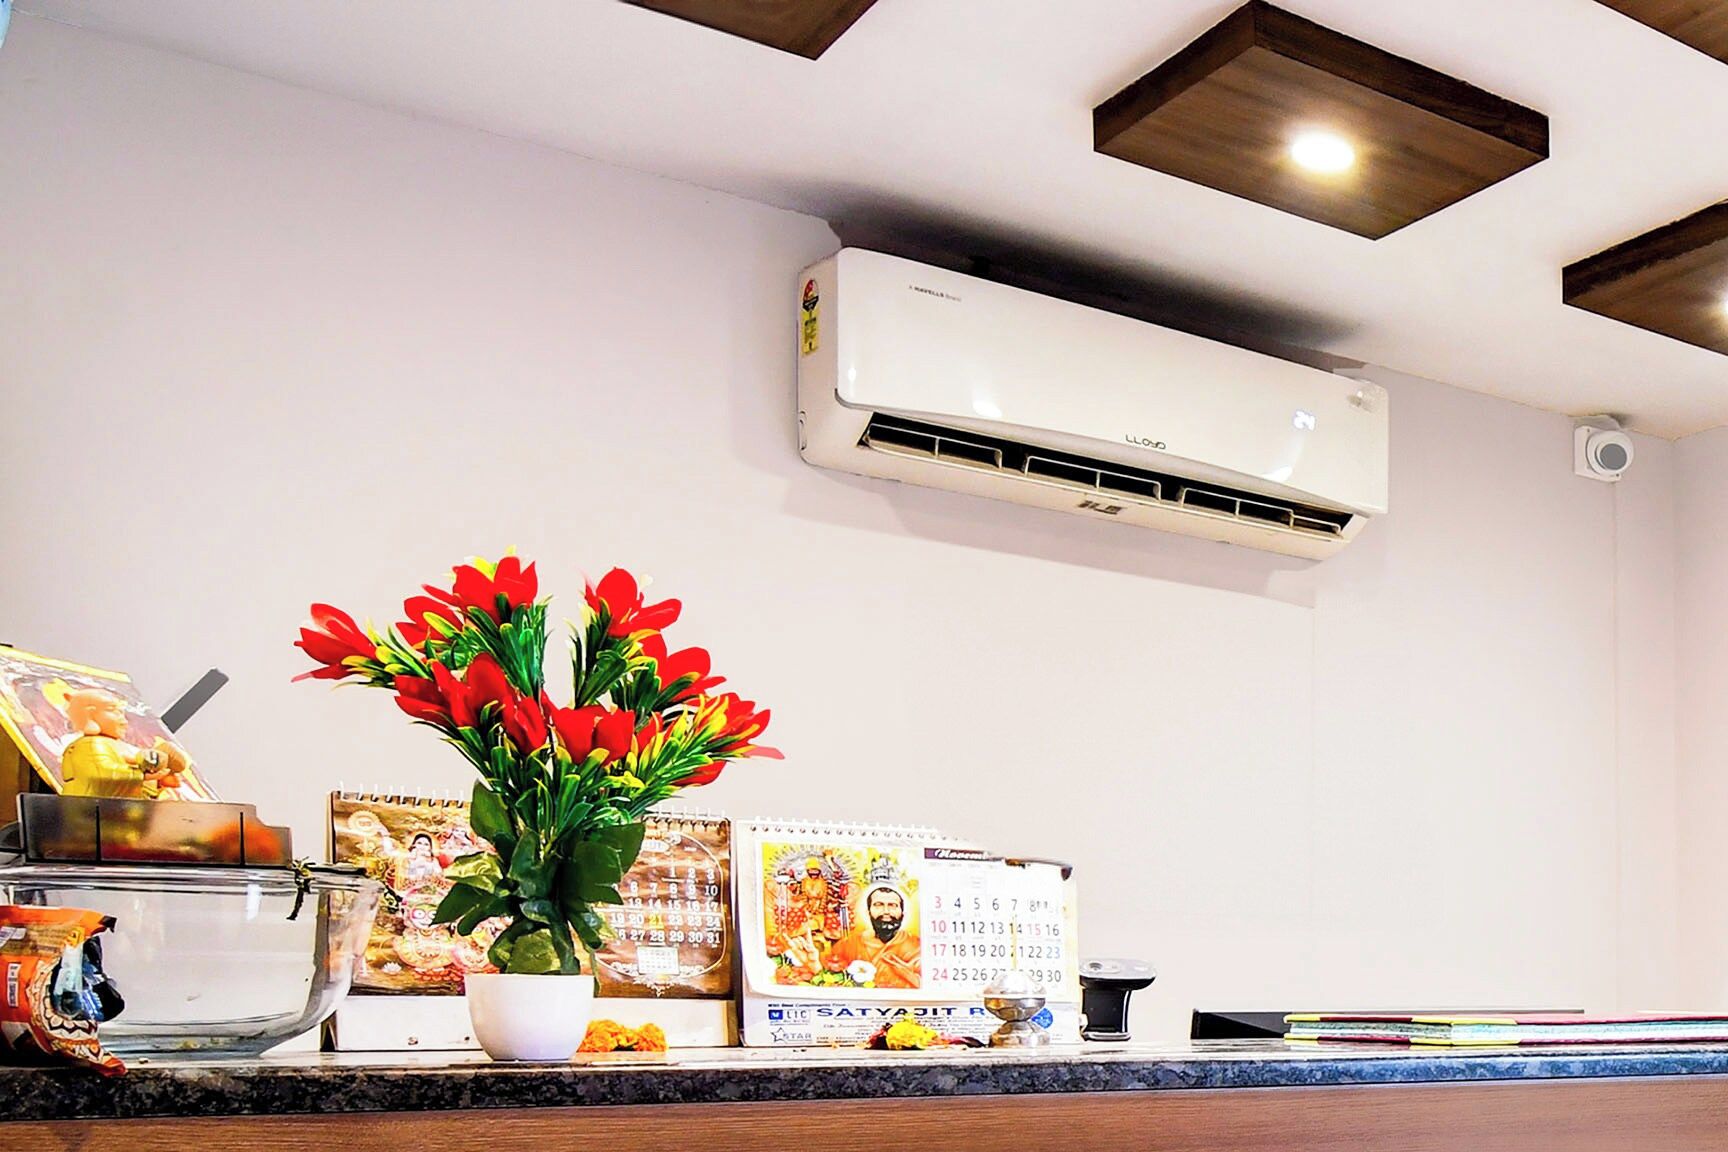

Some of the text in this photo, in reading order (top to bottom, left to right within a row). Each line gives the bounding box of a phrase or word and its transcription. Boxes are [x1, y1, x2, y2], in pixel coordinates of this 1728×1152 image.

[1125, 434, 1167, 450] LLOYD
[705, 885, 718, 896] 10
[705, 901, 718, 912] 17
[935, 896, 942, 908] 3
[954, 897, 961, 908] 4
[974, 897, 980, 910] 5
[992, 898, 999, 911] 6
[1011, 899, 1018, 911] 7
[707, 917, 720, 927] 24
[931, 920, 946, 933] 10
[952, 921, 966, 933] 11
[971, 922, 985, 934] 12
[991, 922, 1004, 934] 13
[1027, 924, 1041, 935] 15
[1046, 924, 1059, 936] 16
[631, 930, 645, 940] 27
[670, 931, 684, 942] 29
[688, 932, 703, 943] 30
[707, 933, 720, 943] 31
[932, 944, 947, 956] 17
[952, 944, 967, 957] 18
[971, 945, 986, 957] 19
[991, 945, 1005, 957] 20
[1028, 946, 1042, 958] 22
[1046, 946, 1060, 958] 23
[932, 968, 948, 981] 24
[952, 968, 968, 981] 25
[972, 968, 987, 981] 26
[1047, 970, 1061, 982] 30
[786, 1010, 807, 1019] LIC
[816, 1008, 957, 1017] SATYAJIT
